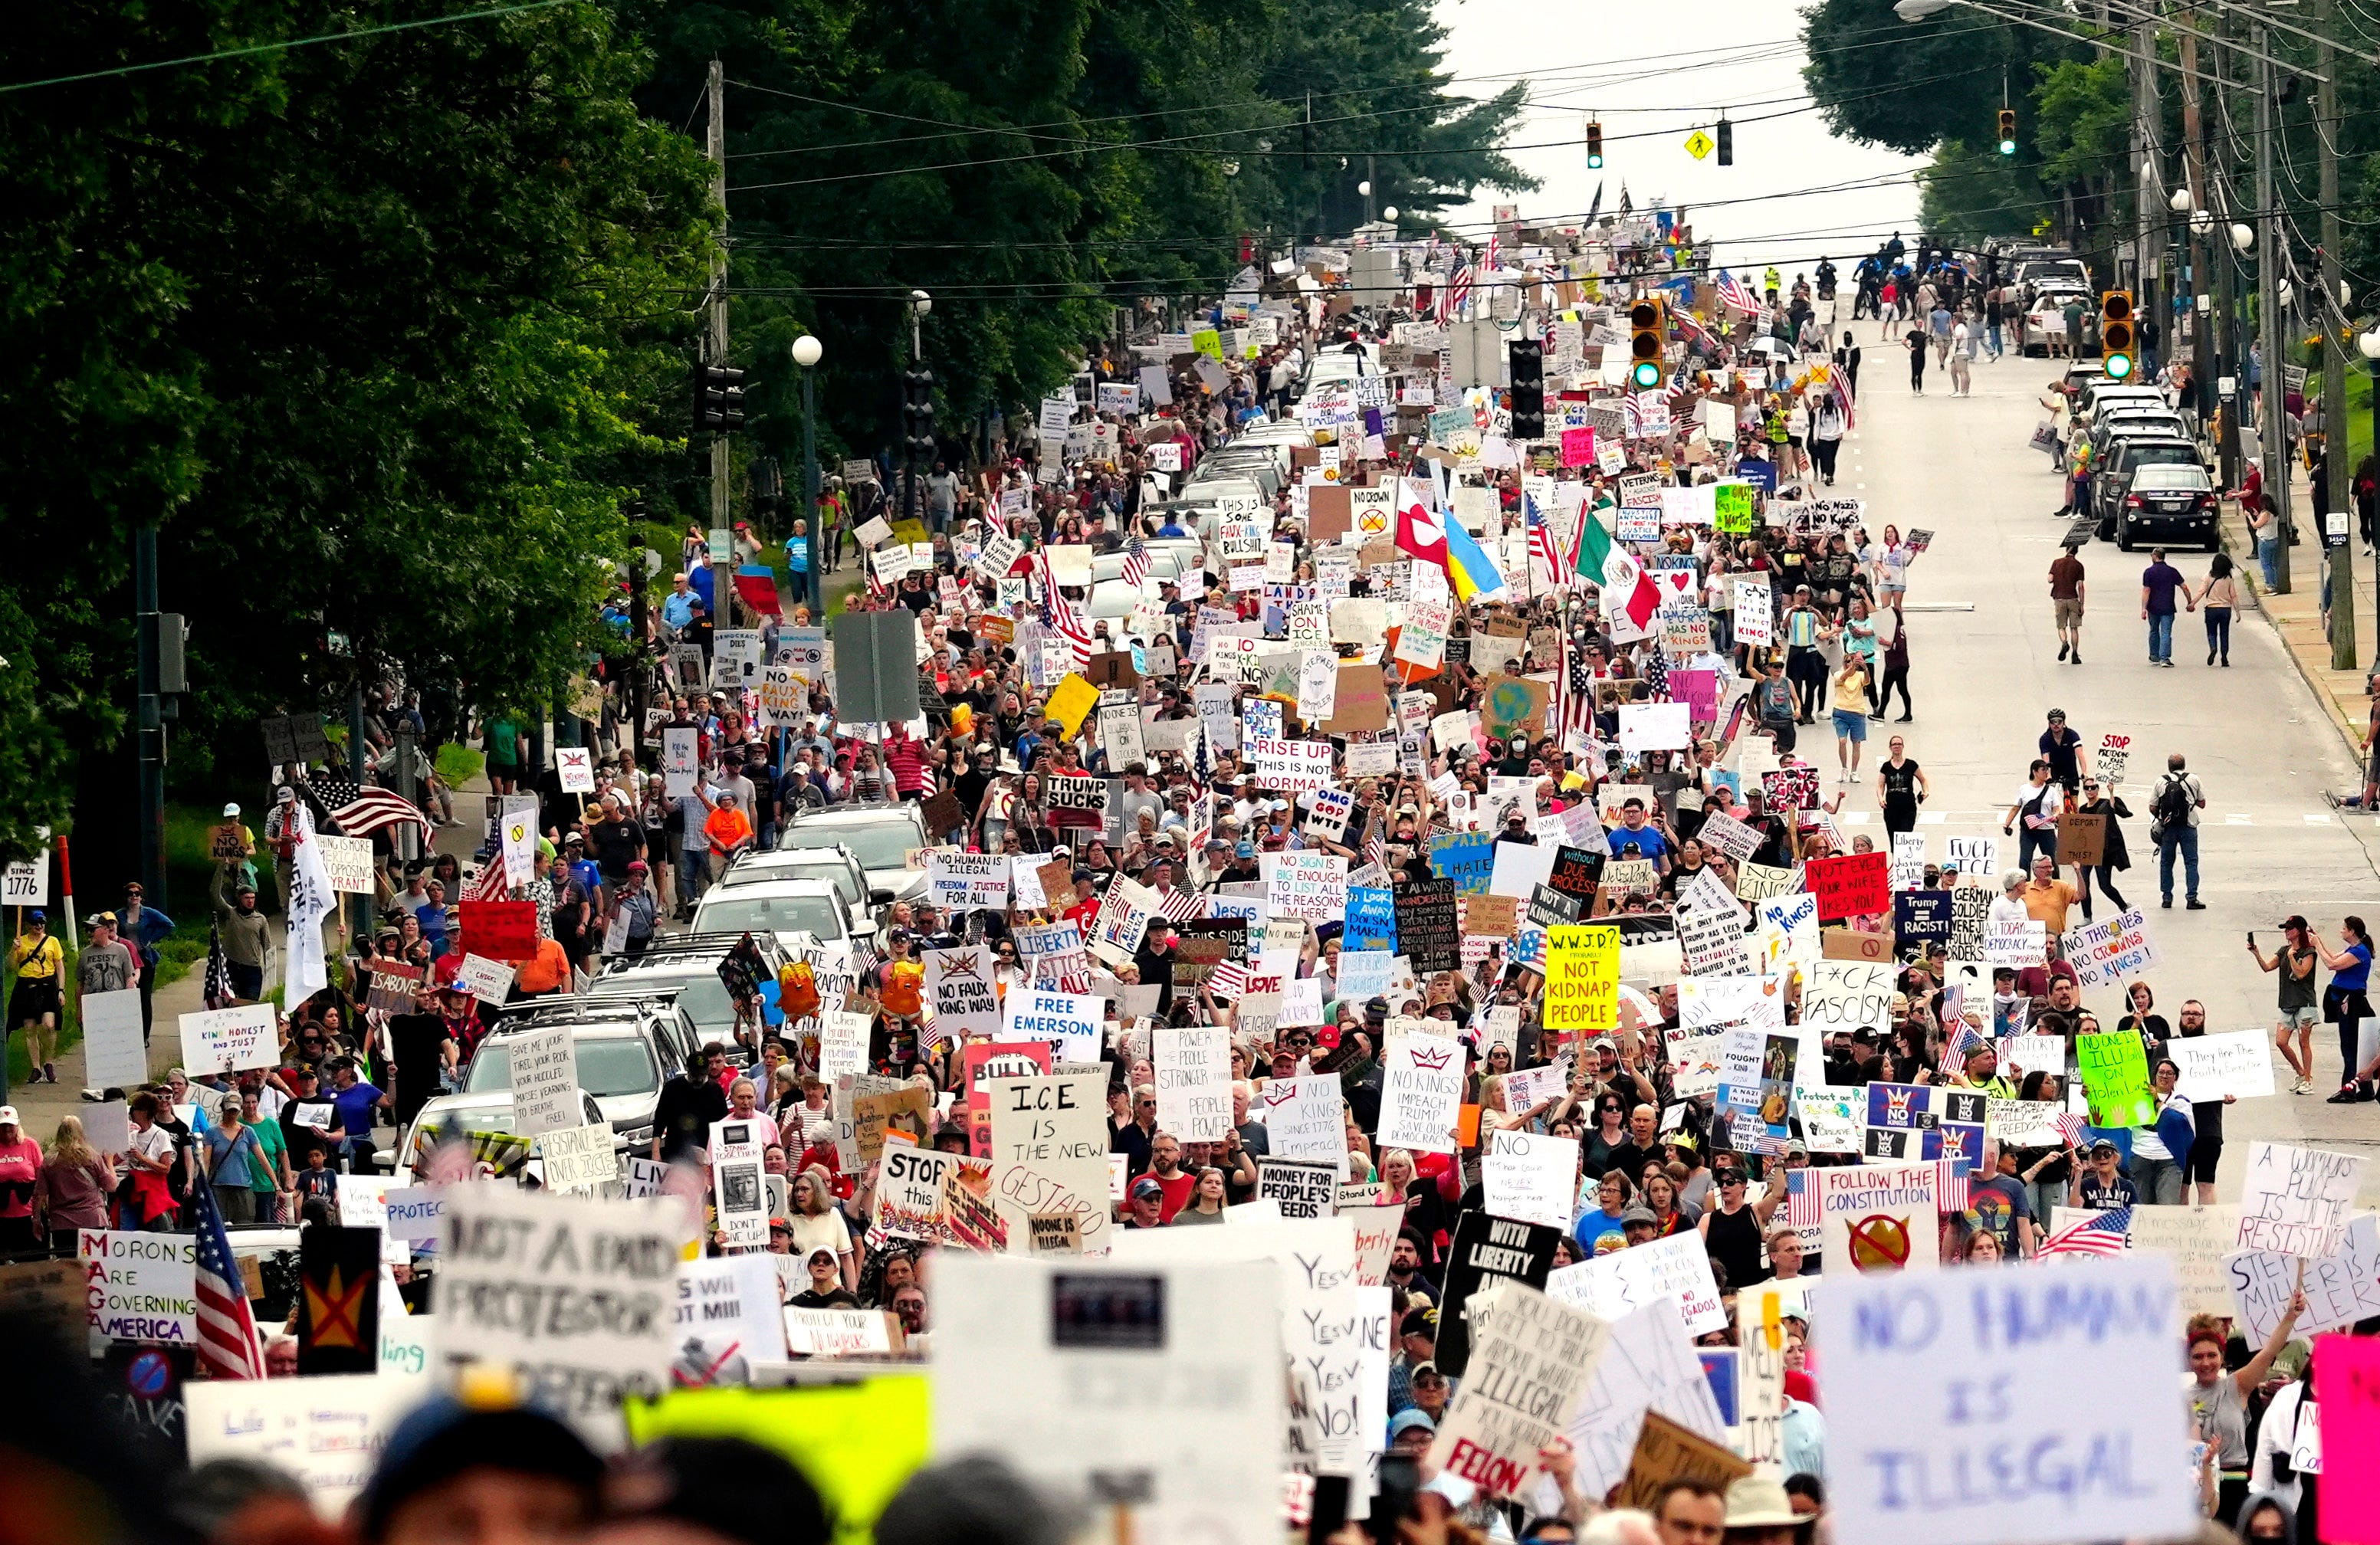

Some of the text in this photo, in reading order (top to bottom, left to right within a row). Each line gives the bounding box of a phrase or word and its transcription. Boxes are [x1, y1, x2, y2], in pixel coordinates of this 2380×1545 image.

[1355, 377, 1385, 390] HOPE
[1356, 390, 1386, 400] WILL
[1622, 473, 1660, 487] VETERANS
[1223, 498, 1258, 512] THIS IS
[1354, 491, 1390, 504] NO CROWN
[1626, 494, 1663, 508] FASCISM
[1226, 513, 1252, 523] SOME
[990, 544, 1015, 560] Lying
[996, 536, 1016, 552] Make
[980, 559, 1003, 576] Again
[984, 550, 1009, 570] Wrong
[1292, 602, 1323, 616] SHAME
[1294, 617, 1318, 628] ON
[1666, 625, 1706, 634] HAS NO
[1292, 629, 1321, 641] ICE
[1671, 635, 1706, 646] KINGS
[766, 670, 787, 683] NO
[762, 696, 799, 709] KING
[767, 707, 804, 720] WAY!
[1258, 740, 1331, 759] RISE UP
[2102, 734, 2131, 749] STOP
[1257, 760, 1331, 775] THIS IS NOT
[2096, 760, 2125, 772] RACISM
[1048, 777, 1106, 793] TRUMP
[1049, 792, 1105, 809] SUCKS
[1318, 790, 1349, 805] OMG
[1311, 815, 1342, 830] WTF
[2070, 818, 2099, 827] DEPORT
[217, 837, 238, 847] NO
[1951, 839, 1994, 858] FUCK
[213, 846, 245, 858] KINGS
[1564, 850, 1595, 864] without
[2068, 850, 2093, 860] THIS!
[937, 855, 1002, 866] NO HUMAN IS
[1281, 855, 1334, 869] NO SIGN IS
[1811, 857, 1886, 880] NOT EVEN
[1955, 860, 1993, 874] ICE
[947, 864, 990, 875] ILLEGAL
[1276, 869, 1344, 883] BIG ENOUGH
[1564, 861, 1587, 877] DUE
[7, 877, 38, 896] 1776
[935, 881, 1006, 892] FREEDOM JUSTICE
[1277, 881, 1341, 895] TO LIST ALL
[1550, 874, 1597, 894] PROCESS
[1817, 874, 1880, 896] YOUR WIFE
[946, 891, 988, 904] FOR ALL
[1271, 894, 1344, 907] THE REASONS
[1853, 894, 1876, 910] YOU
[1906, 897, 1938, 908] Trump
[1283, 907, 1328, 919] I'M HERE
[1905, 921, 1948, 933] RACIST!
[2000, 922, 2024, 935] TODAY
[1016, 929, 1081, 955] LIBERTY
[1985, 939, 2027, 950] DEMOCRACY
[2064, 937, 2084, 953] NO
[87, 954, 117, 963] RESIST
[2008, 955, 2047, 963] TOMORROW
[2072, 957, 2091, 970] NO
[1564, 961, 1599, 977] NOT
[2080, 972, 2099, 986] NO
[938, 982, 989, 999] NO FAUX
[1549, 980, 1611, 999] KIDNAP
[968, 997, 995, 1013] WAY
[1036, 998, 1074, 1014] FREE
[1804, 989, 1892, 1025] FASCISM
[1551, 1004, 1607, 1023] PEOPLE
[1014, 1016, 1093, 1036] EMERSON
[972, 1061, 1042, 1081] BULLY
[1391, 1073, 1459, 1094] NO KINGS
[1508, 1075, 1516, 1084] NO
[1509, 1082, 1529, 1092] KINGS
[1010, 1084, 1079, 1111] I.C.E.
[1306, 1082, 1330, 1097] NO
[1511, 1092, 1530, 1102] SINCE
[1302, 1100, 1343, 1116] KINGS
[1397, 1094, 1447, 1110] IMPEACH
[1512, 1101, 1531, 1111] 1776
[1399, 1106, 1440, 1120] TRUMP
[1033, 1120, 1055, 1140] IS
[1283, 1121, 1335, 1134] SINCE 1776
[1399, 1120, 1448, 1134] SAVE OUR
[542, 1128, 589, 1158] RESISTANCE
[1390, 1130, 1448, 1145] DEMOCRACY
[1496, 1135, 1530, 1156] NO
[1013, 1143, 1103, 1161] THE NEW
[1279, 1139, 1343, 1156] Impeach
[2259, 1145, 2273, 1166] A
[550, 1152, 614, 1183] OVER ICE
[888, 1152, 946, 1184] STOP
[1263, 1168, 1331, 1186] MONEY FOR
[1830, 1169, 1932, 1190] FOLLOW THE
[2288, 1171, 2330, 1199] PLACE
[904, 1188, 932, 1205] this
[1001, 1165, 1104, 1235] GESTAPO
[1261, 1185, 1331, 1203] PEOPLE'S
[1826, 1187, 1931, 1212] CONSTITUTION
[2253, 1192, 2349, 1226] IS IN THE
[1489, 1220, 1529, 1247] WITH
[2237, 1217, 2346, 1259] RESISTANCE
[83, 1234, 196, 1263] MORONS
[1469, 1243, 1535, 1274] LIBERTY
[88, 1261, 137, 1284] ARE
[88, 1288, 196, 1315] GOVERNING
[1853, 1282, 2174, 1353] NO HUMAN
[89, 1316, 183, 1340] AMERICA
[1946, 1376, 2014, 1424] IS
[1866, 1432, 2156, 1511] ILLEGAL
